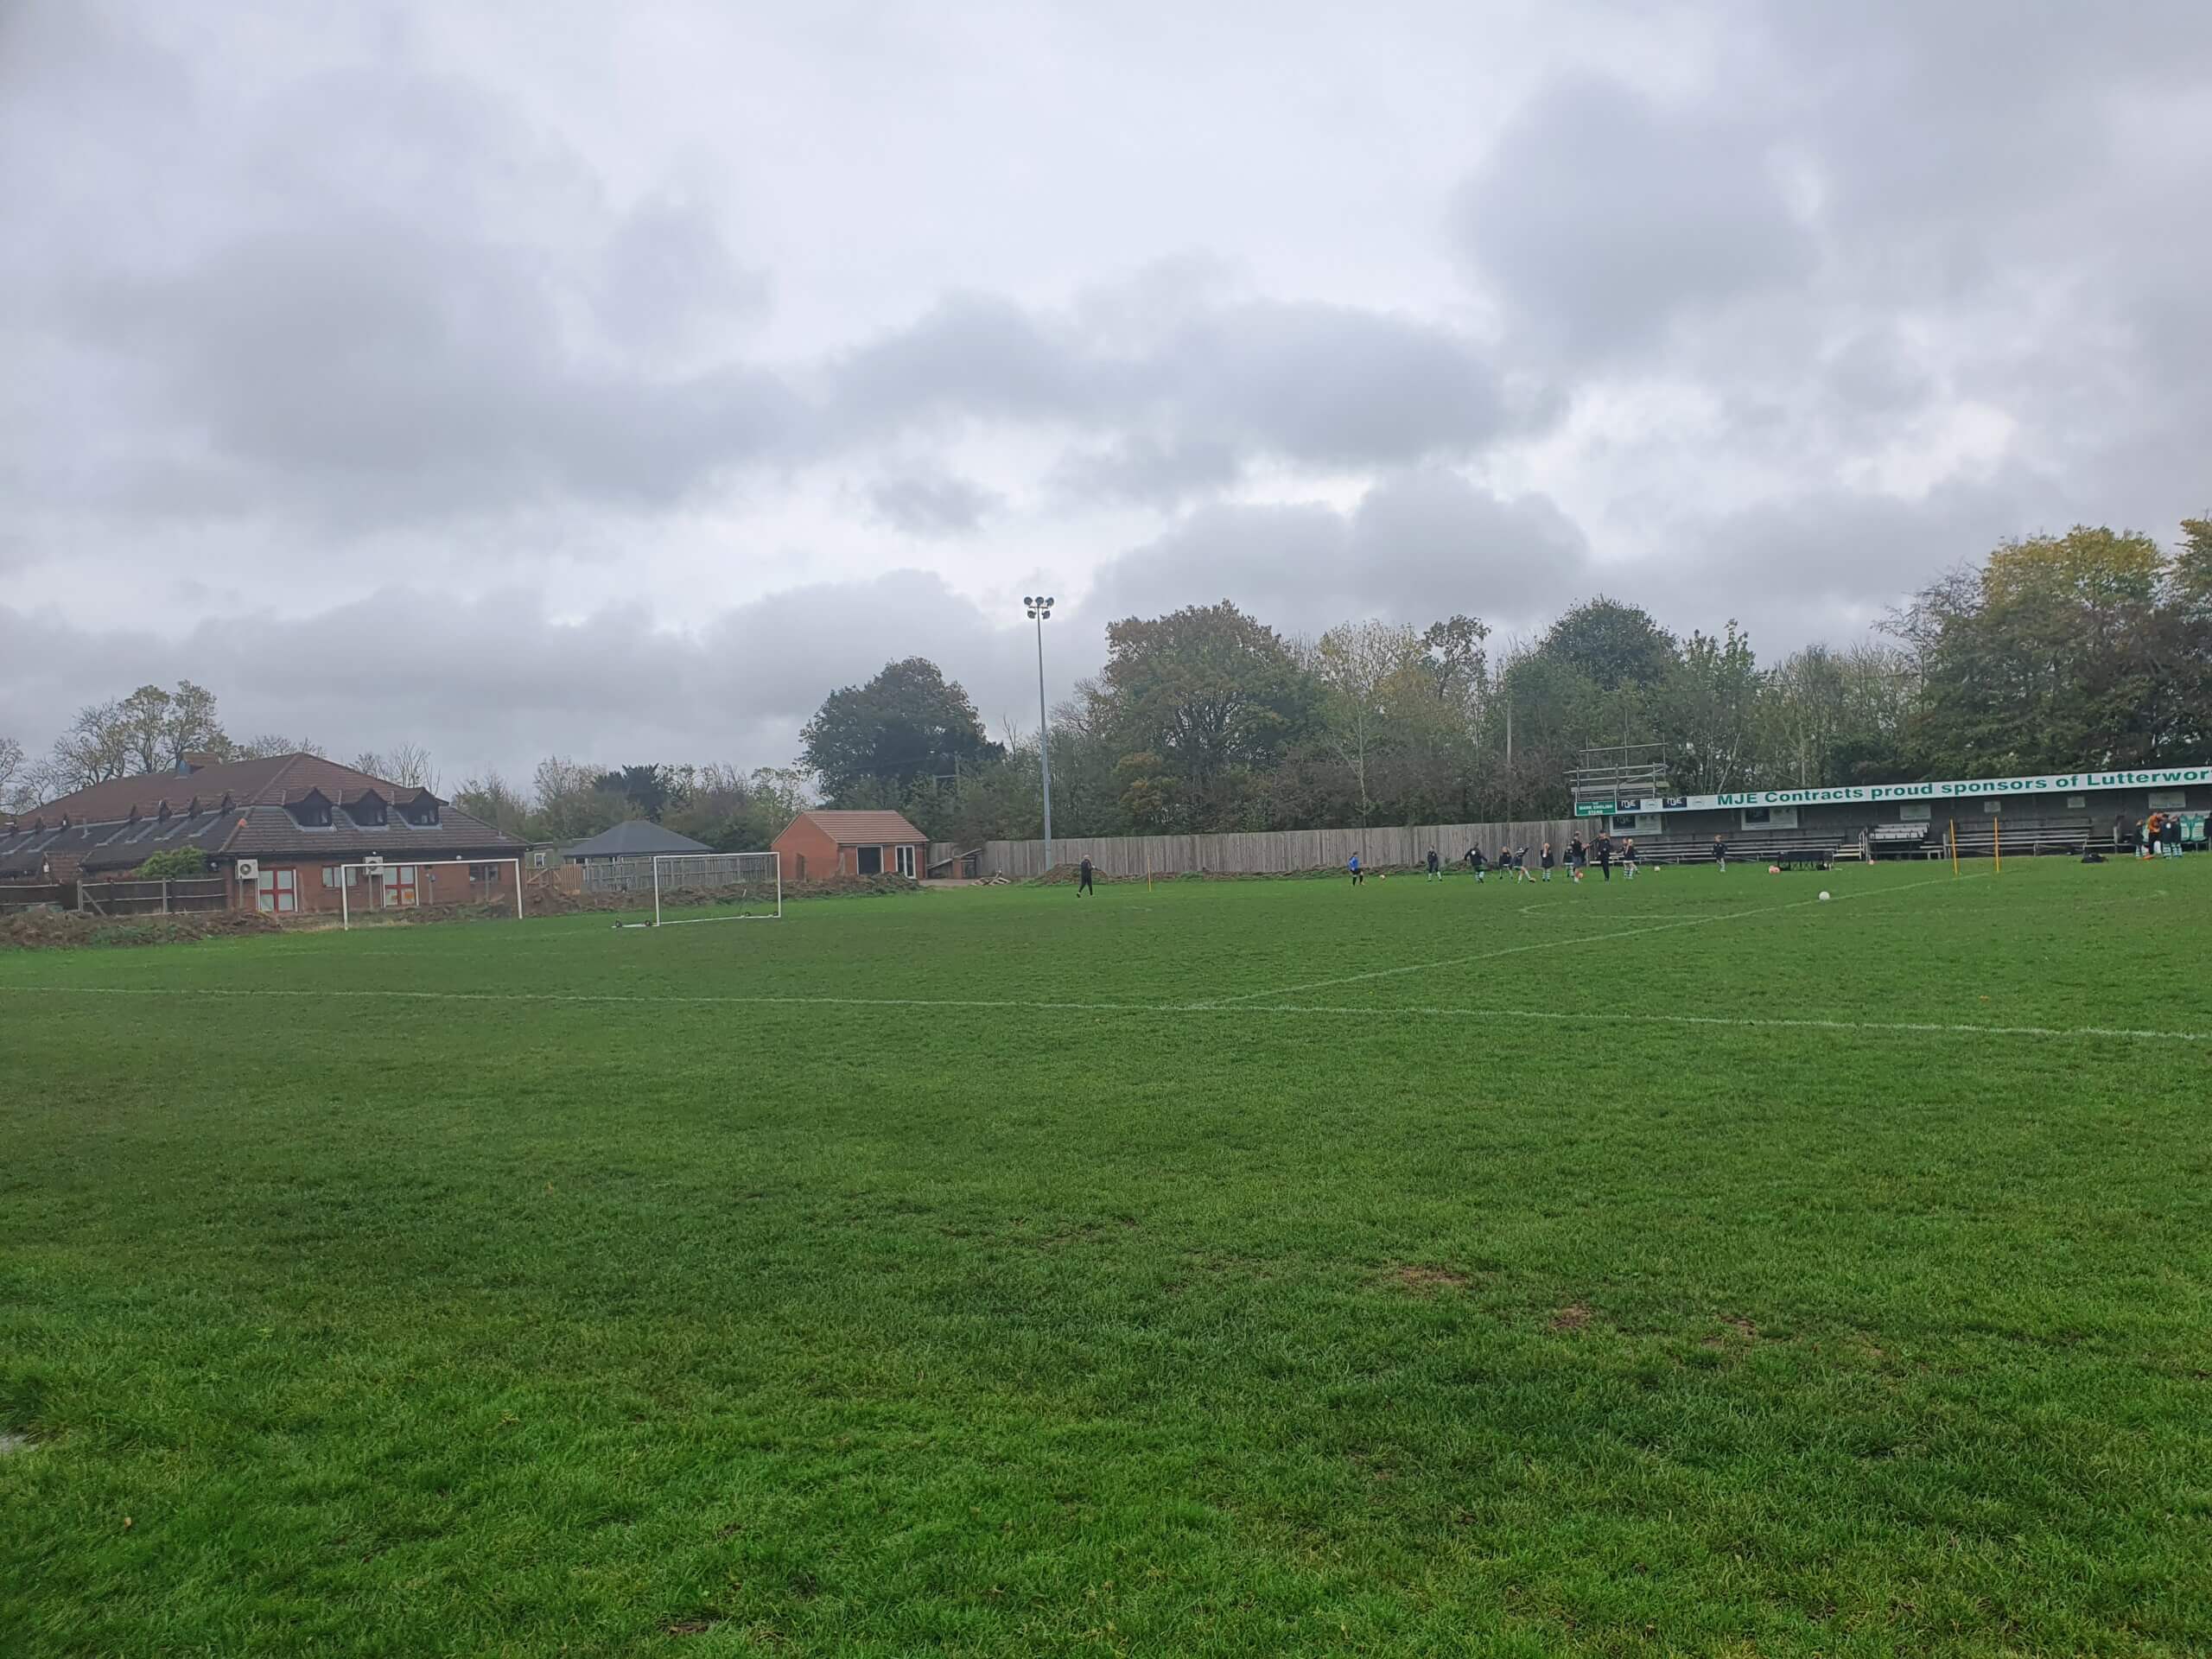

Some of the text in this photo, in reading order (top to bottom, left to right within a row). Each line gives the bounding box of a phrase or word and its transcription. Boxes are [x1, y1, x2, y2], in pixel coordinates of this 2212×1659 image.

[1718, 770, 2212, 805] MJE Contracts proud sponsors of Lutterwor
